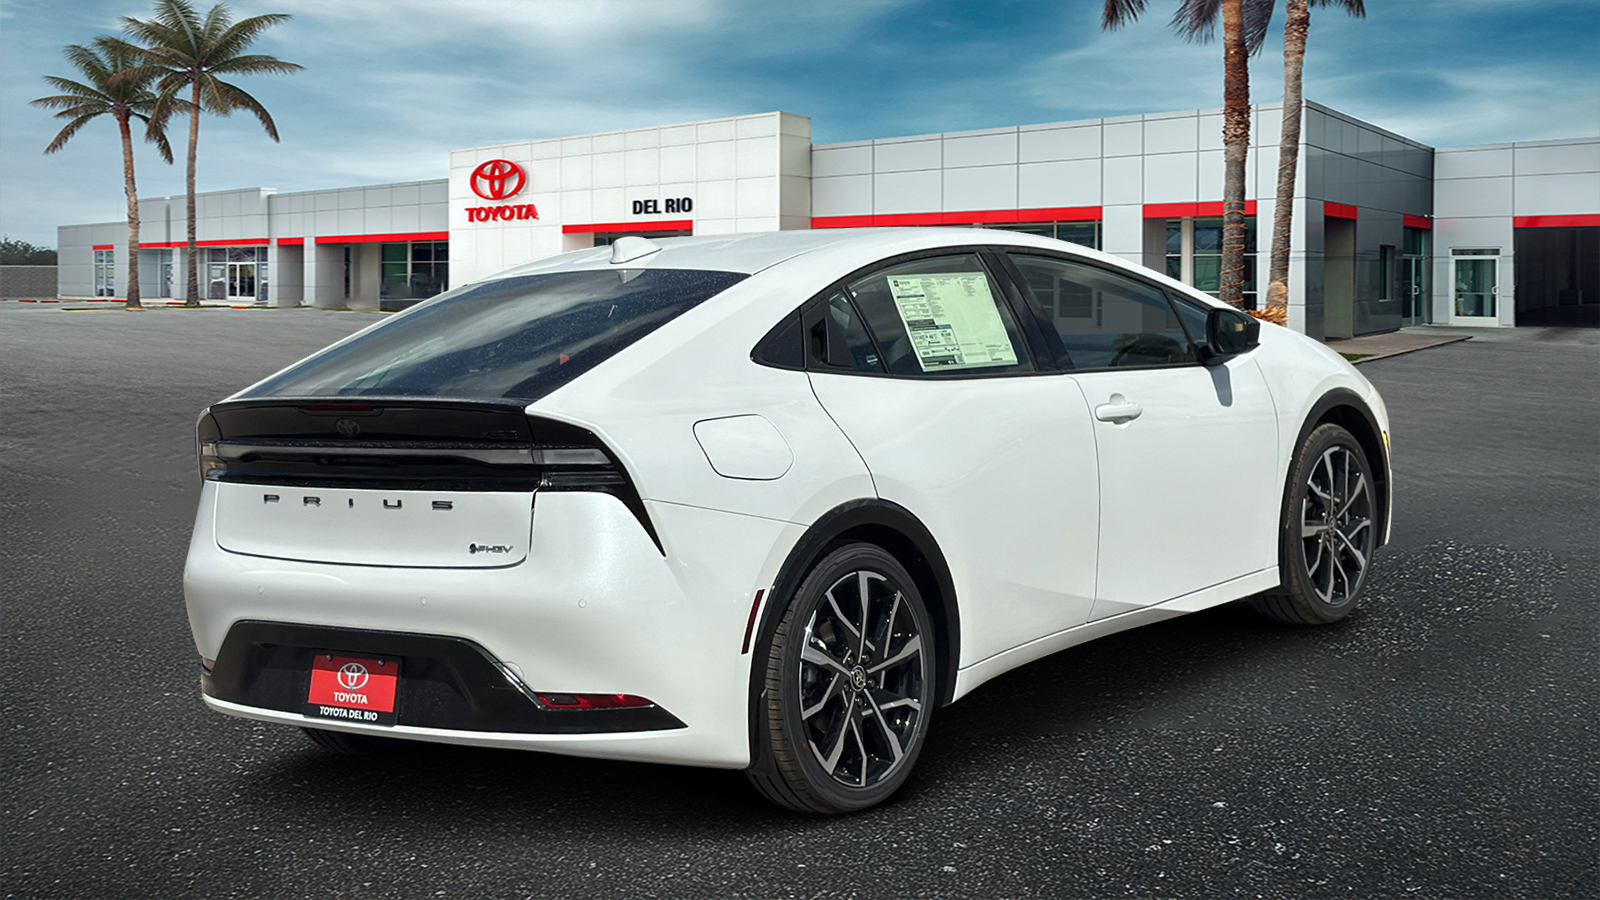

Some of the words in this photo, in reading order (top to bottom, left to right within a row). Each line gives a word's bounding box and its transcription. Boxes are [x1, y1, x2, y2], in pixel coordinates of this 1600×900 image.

[464, 204, 539, 222] TOYOTA
[632, 199, 662, 215] DEL
[665, 197, 693, 213] RIO
[263, 494, 454, 511] PRIUS
[333, 692, 368, 704] TOYOTA
[319, 706, 348, 718] TOYOTA
[348, 710, 363, 720] DEL
[363, 711, 378, 721] RIO
